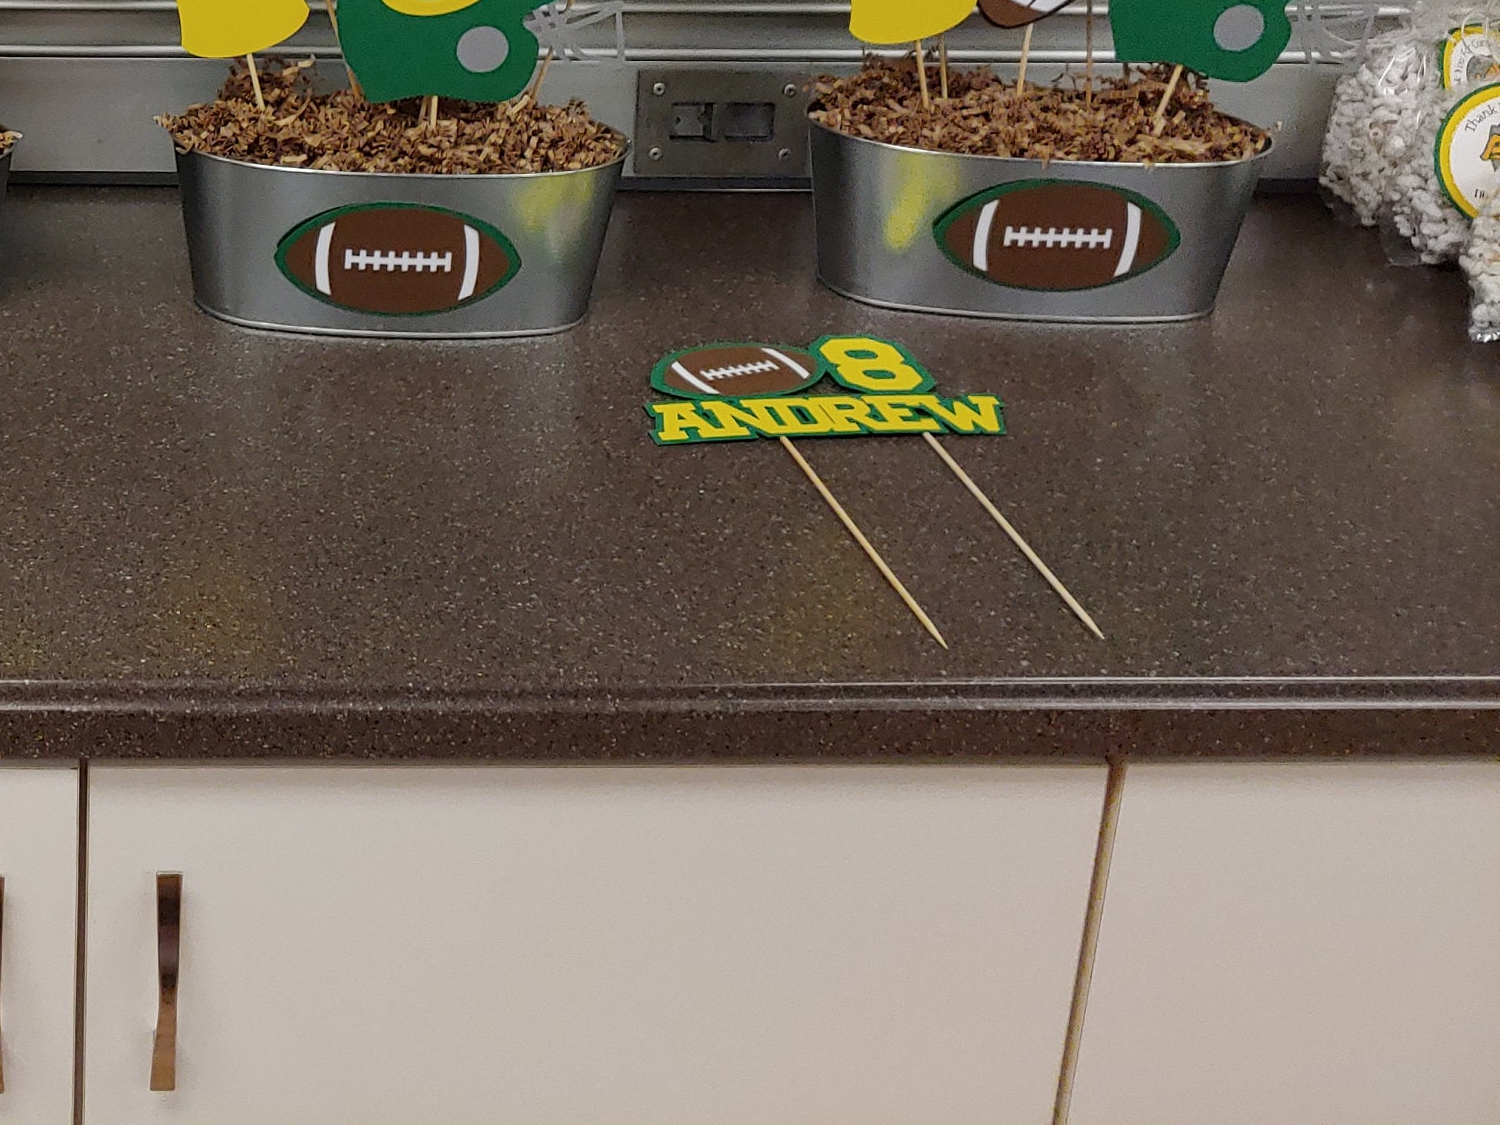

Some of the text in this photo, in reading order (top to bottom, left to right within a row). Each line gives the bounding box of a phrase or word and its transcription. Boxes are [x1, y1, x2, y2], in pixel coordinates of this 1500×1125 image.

[1464, 104, 1497, 132] Thank
[819, 337, 923, 391] 8
[653, 394, 1001, 441] ANDREW
